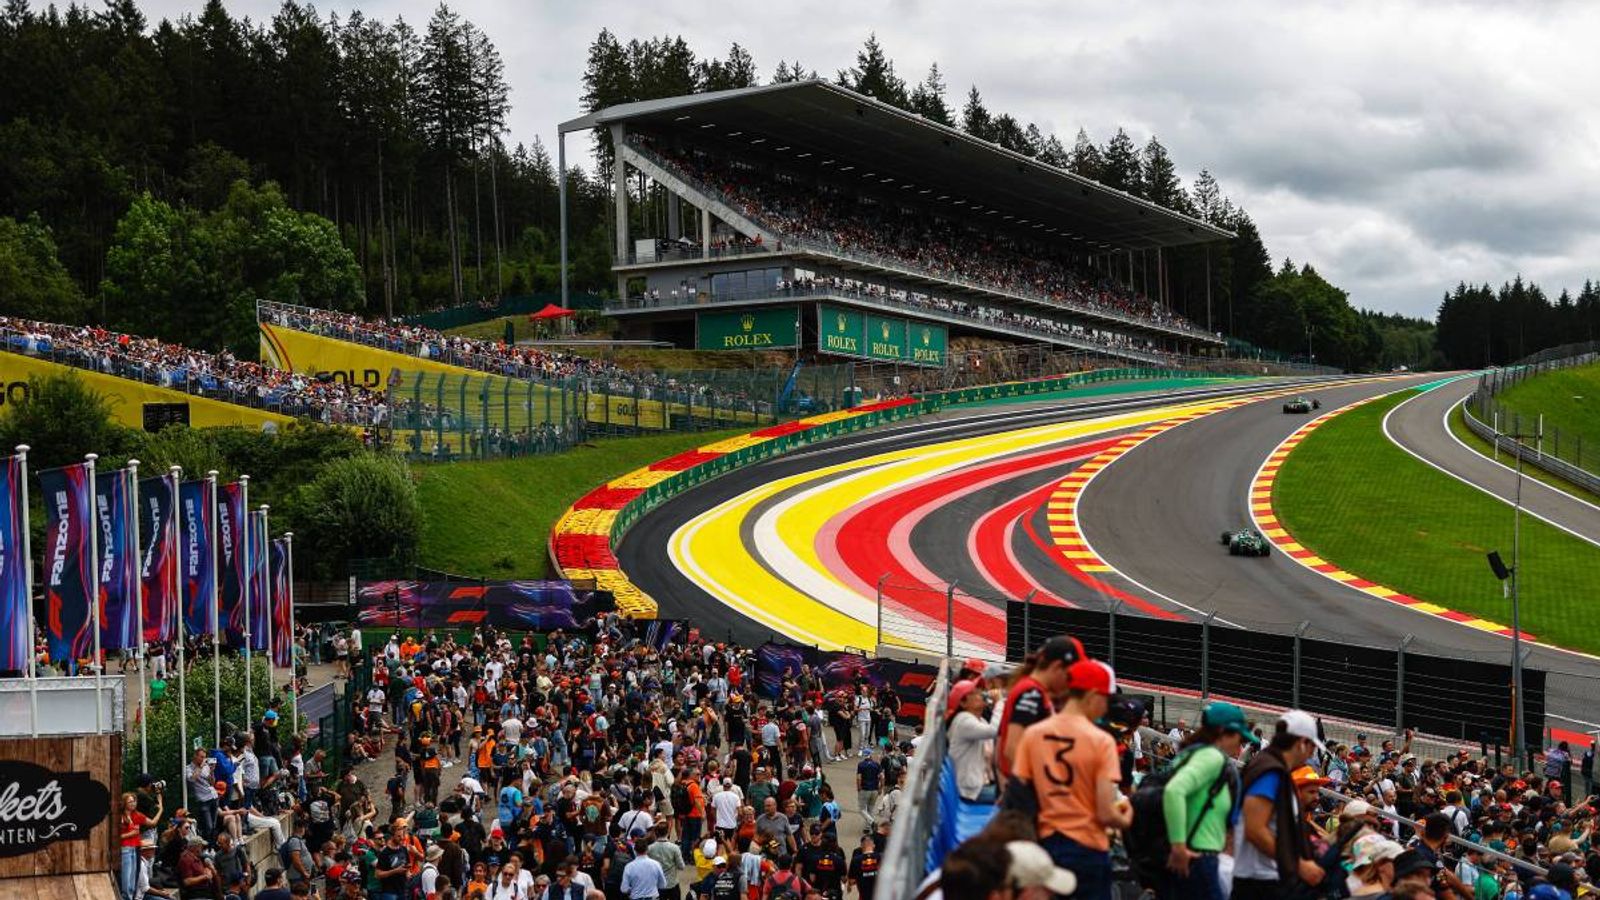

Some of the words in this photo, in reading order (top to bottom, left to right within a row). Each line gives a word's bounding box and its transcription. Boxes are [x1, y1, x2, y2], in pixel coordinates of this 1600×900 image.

[724, 333, 773, 346] ROLEX
[827, 335, 857, 350] ROLEX
[873, 342, 900, 357] ROLEX
[914, 348, 940, 362] ROLEX
